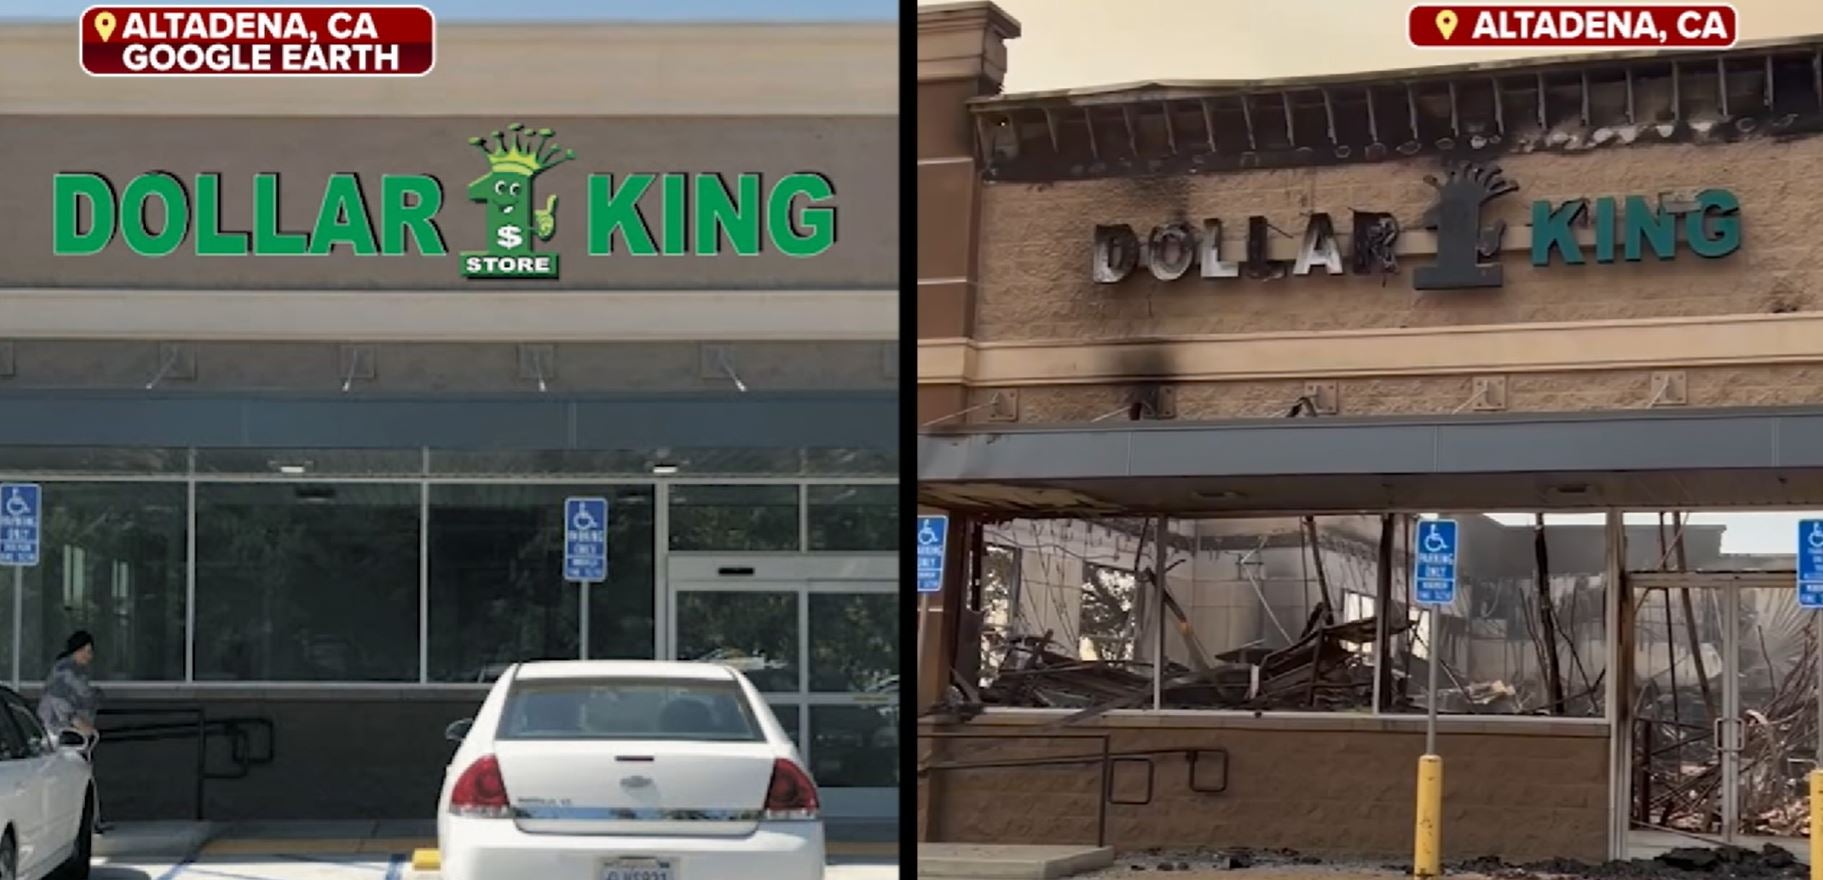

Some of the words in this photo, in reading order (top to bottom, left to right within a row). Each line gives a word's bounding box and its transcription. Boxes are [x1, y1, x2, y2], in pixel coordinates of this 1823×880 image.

[53, 172, 447, 256] DOLLAR
[587, 172, 837, 258] KING
[1093, 211, 1399, 284] DOLLAR
[1531, 188, 1741, 267] KING
[466, 257, 550, 272] STORE
